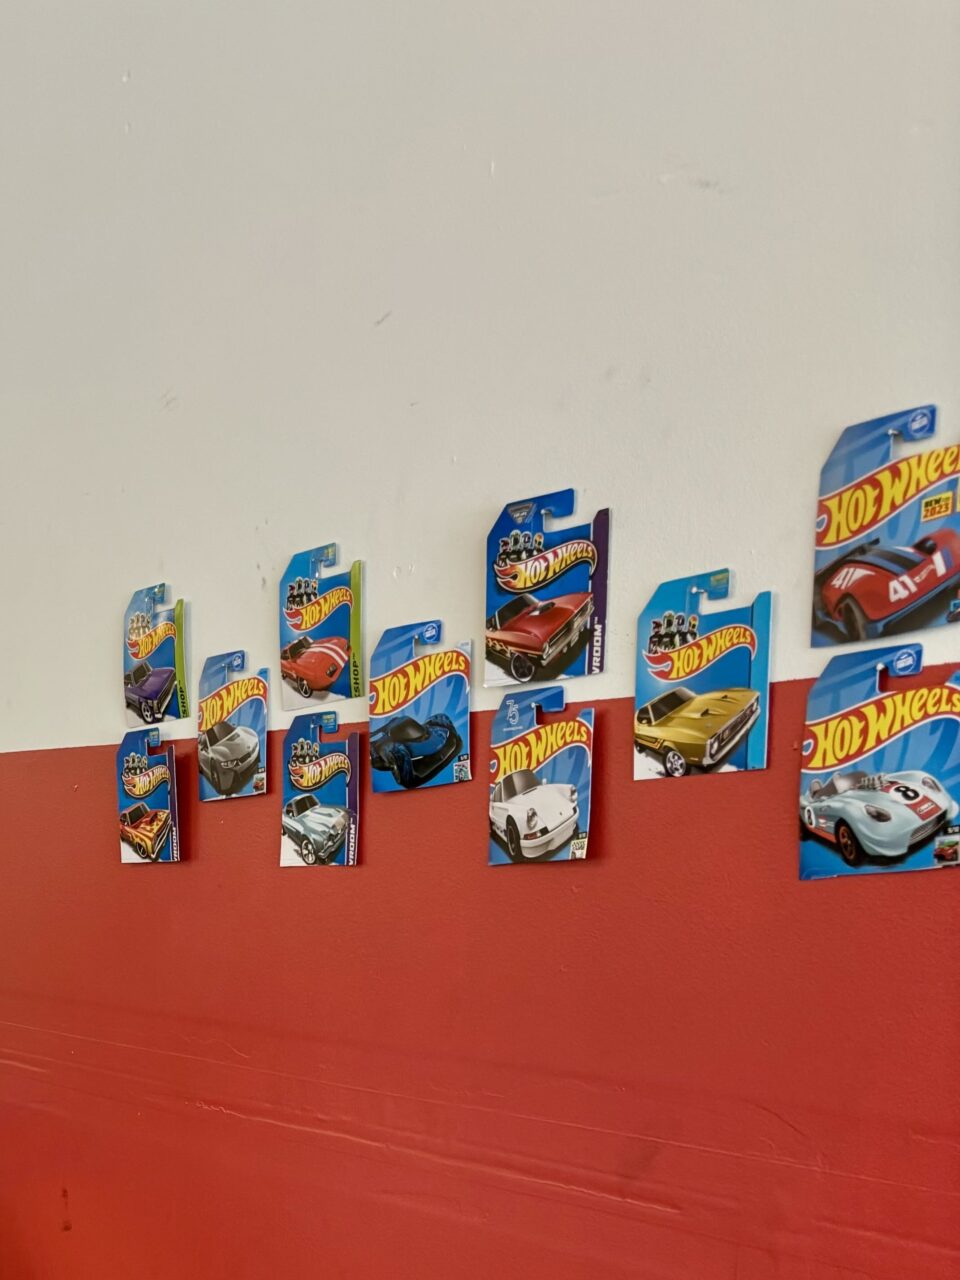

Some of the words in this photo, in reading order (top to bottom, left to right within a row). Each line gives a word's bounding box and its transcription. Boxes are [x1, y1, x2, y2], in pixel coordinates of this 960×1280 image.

[875, 445, 960, 521] WHEE
[923, 502, 950, 519] 2023
[888, 574, 918, 603] 41
[894, 785, 920, 801] 8
